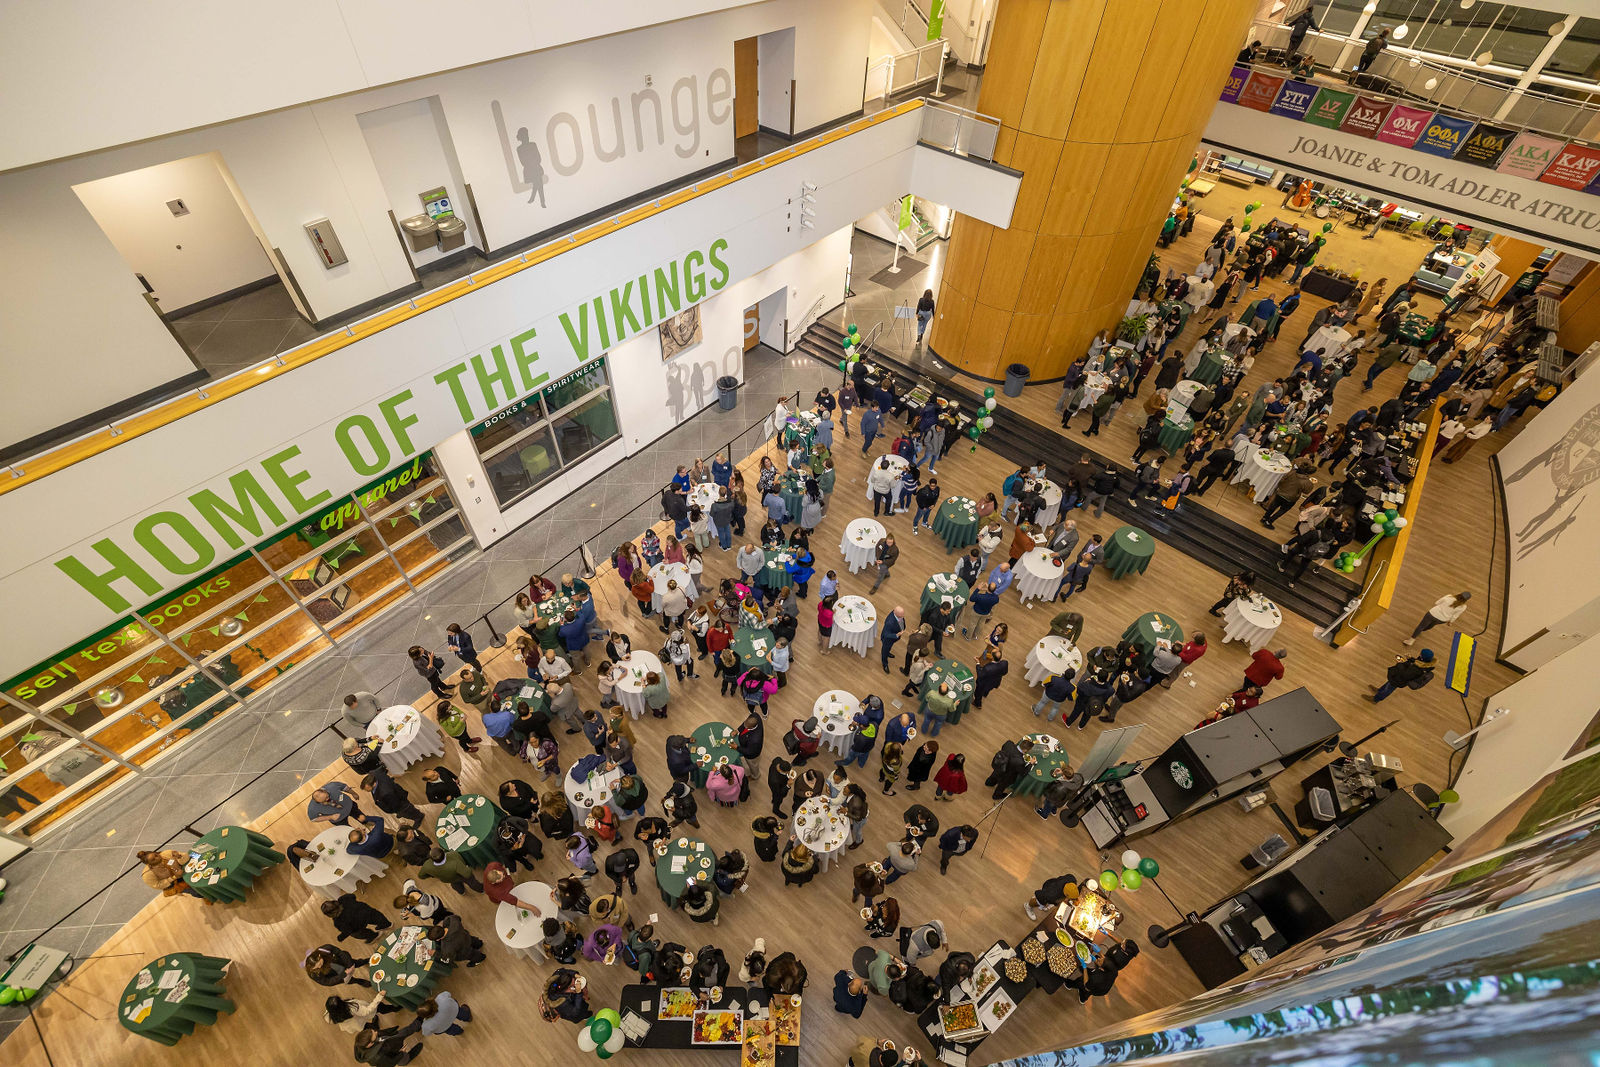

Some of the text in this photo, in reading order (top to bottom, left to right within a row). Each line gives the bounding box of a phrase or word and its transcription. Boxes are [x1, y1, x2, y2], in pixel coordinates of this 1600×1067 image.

[491, 68, 732, 194] Lounge
[1288, 136, 1600, 233] JOANIE & TOM ADLER ATRIU
[54, 238, 730, 614] HOME OF THE VIKINGS
[484, 360, 601, 428] BOOKS & SPIRITWEAR
[320, 456, 423, 531] apparel
[15, 661, 78, 700] sell
